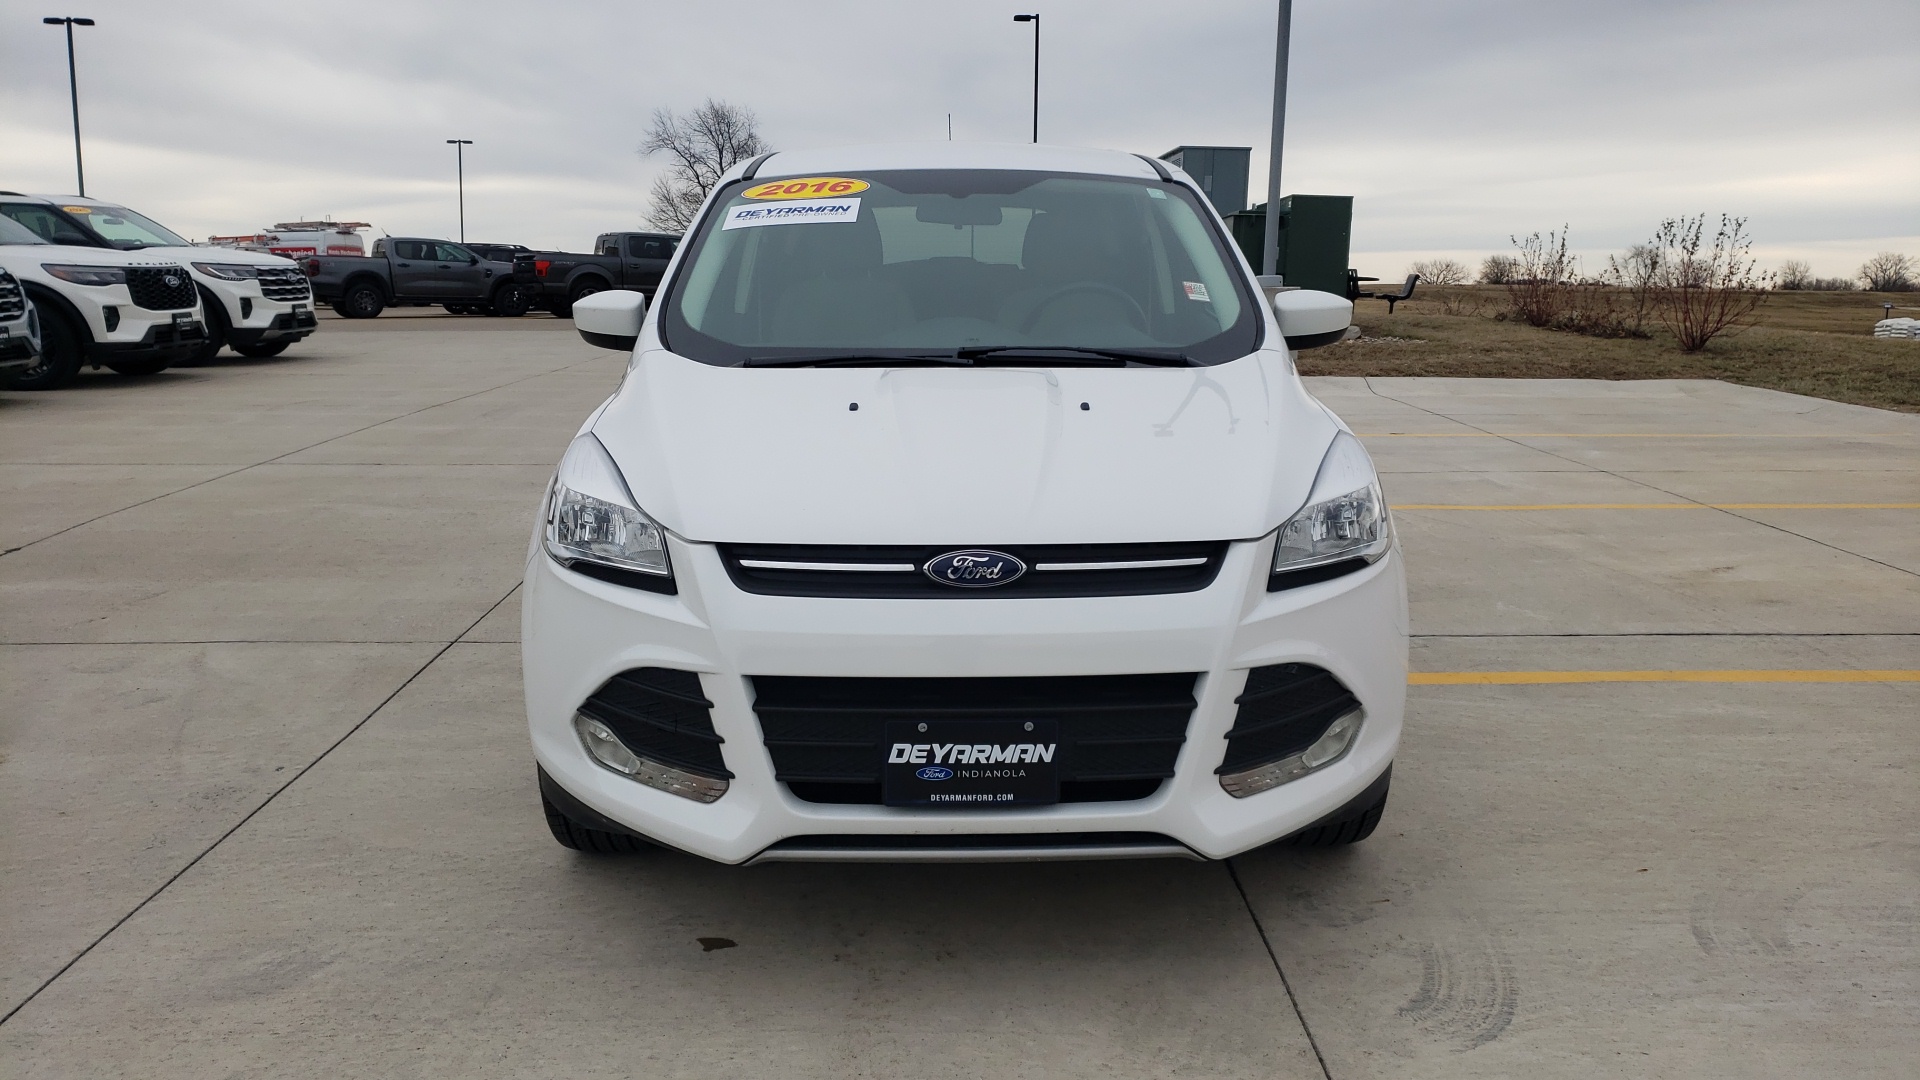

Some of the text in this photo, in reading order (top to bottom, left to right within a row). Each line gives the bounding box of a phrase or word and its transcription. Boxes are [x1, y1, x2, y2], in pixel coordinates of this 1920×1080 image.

[755, 181, 855, 197] 2016
[735, 205, 852, 218] DEYARMAN
[742, 213, 790, 221] CERTIFIED
[947, 555, 1003, 579] Ford
[888, 743, 1056, 764] DEYARMAN
[957, 769, 1026, 778] INDIANOLA
[930, 793, 1014, 801] DEYARMANFORD.COM
